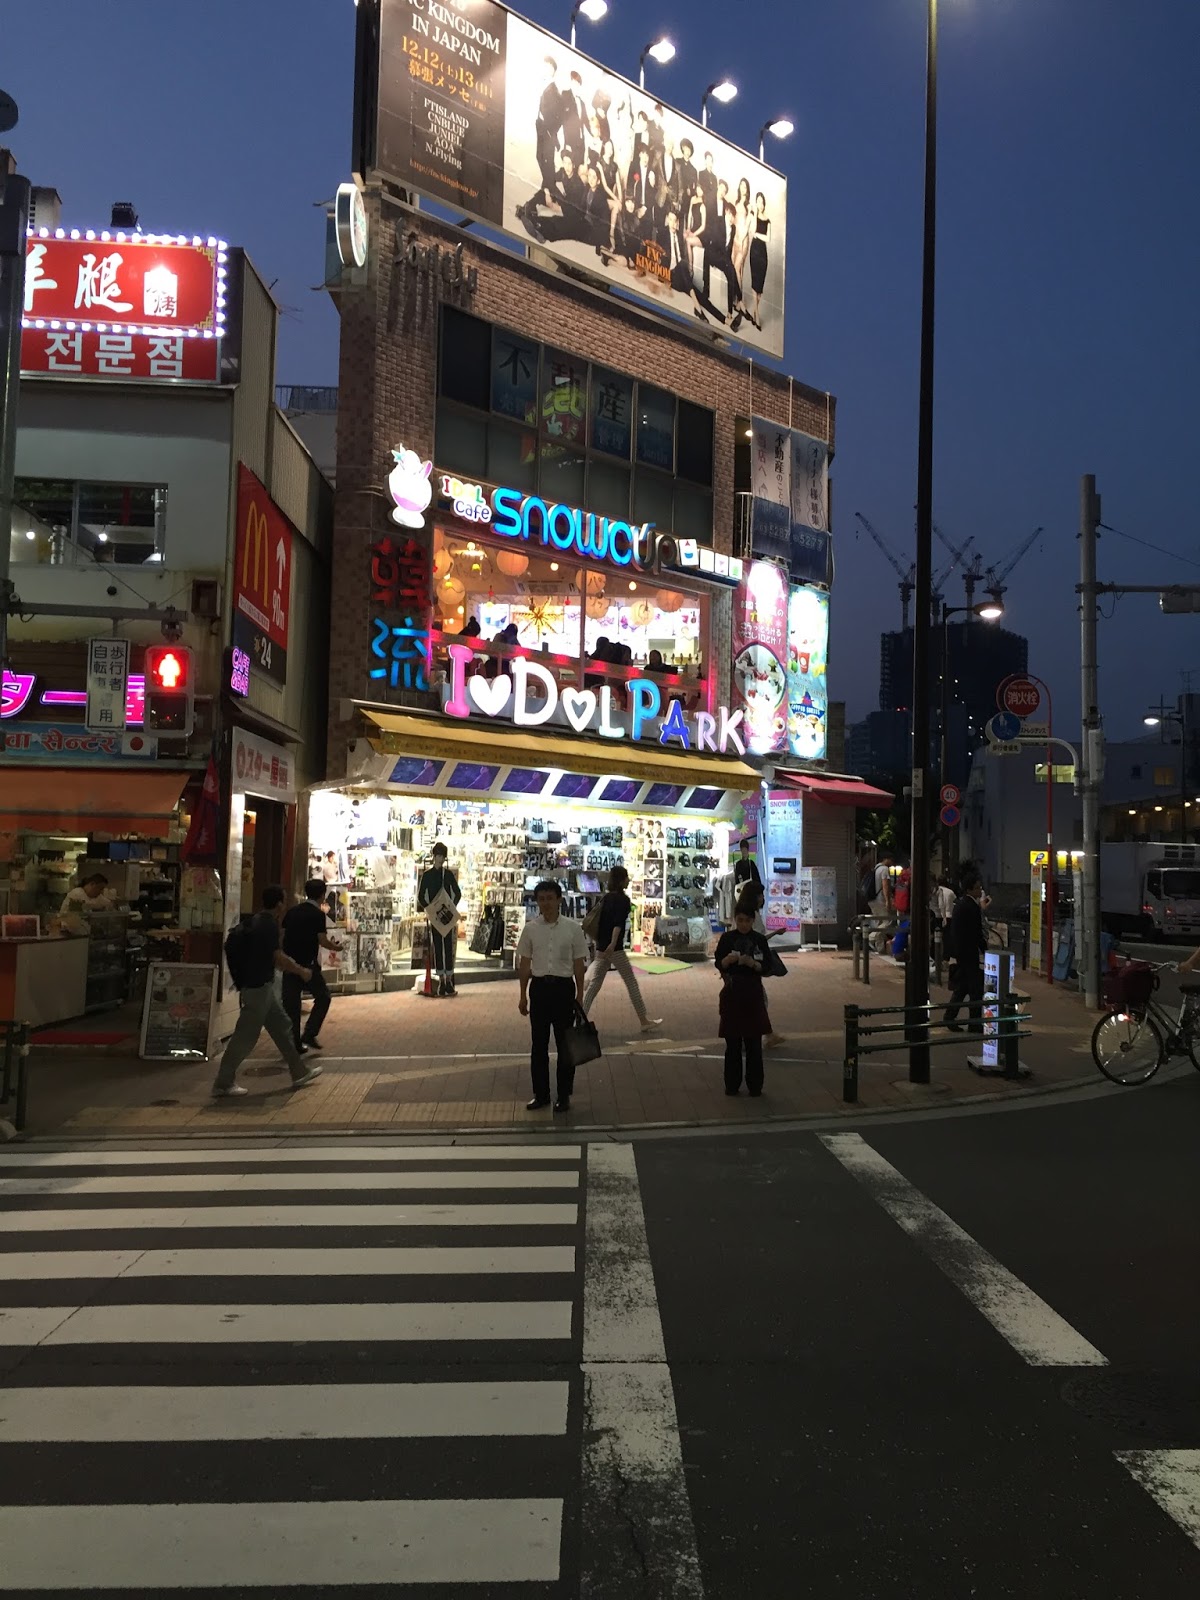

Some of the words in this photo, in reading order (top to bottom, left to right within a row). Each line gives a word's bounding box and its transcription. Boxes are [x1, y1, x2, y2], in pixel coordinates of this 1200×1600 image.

[412, 13, 429, 36] IN
[433, 27, 482, 65] JAPAN
[428, 0, 500, 54] KINGDOM
[424, 98, 469, 129] FTISLAND
[427, 111, 465, 138] CNBLUE
[429, 123, 462, 147] JUNIEL
[434, 137, 455, 154] AOA
[44, 332, 184, 377] 전문점
[455, 500, 490, 520] Cafe
[261, 636, 271, 669] 24
[109, 646, 124, 691] 歩行者
[1007, 691, 1038, 705] 消火栓
[628, 678, 745, 756] PARK
[788, 800, 801, 808] CUP
[945, 791, 956, 799] 40
